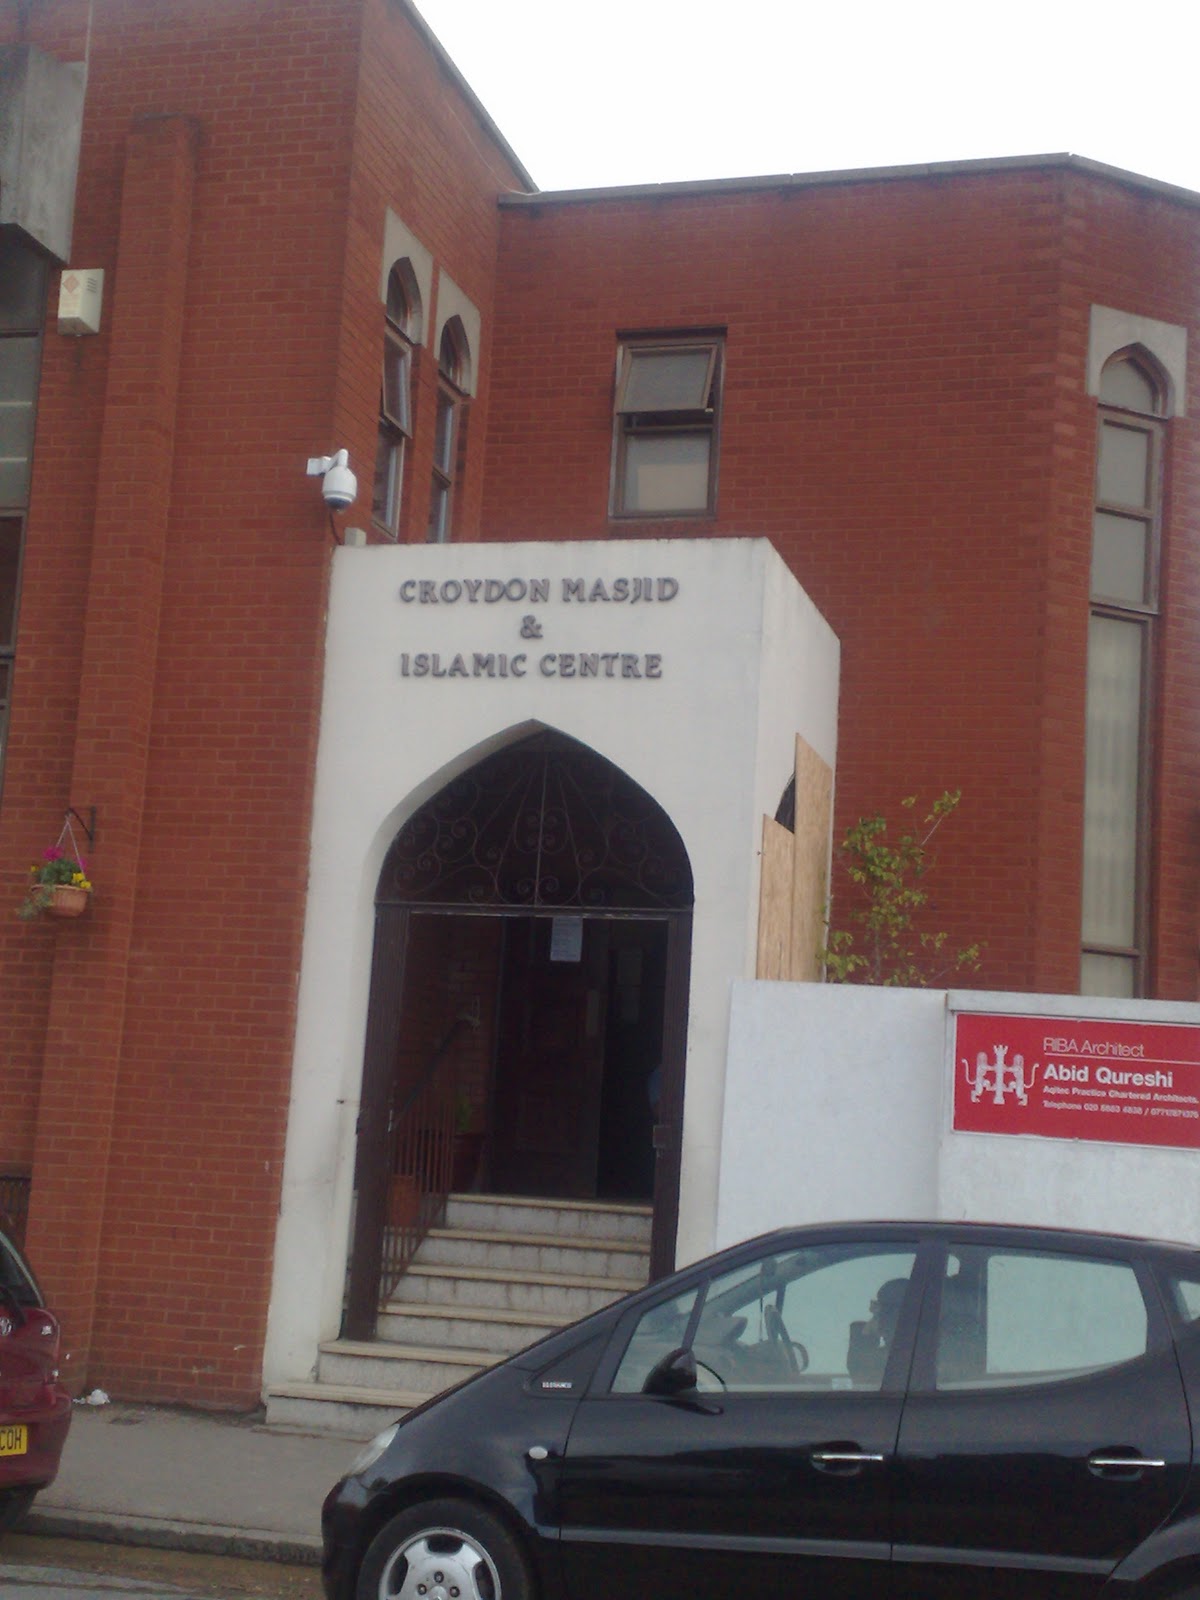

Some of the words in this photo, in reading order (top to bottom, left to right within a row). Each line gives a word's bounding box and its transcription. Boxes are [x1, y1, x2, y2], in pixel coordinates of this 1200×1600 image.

[400, 578, 550, 604] CROYDON
[562, 577, 680, 604] MASJID
[520, 614, 543, 639] &
[401, 653, 527, 678] ISLAMIC
[539, 652, 662, 679] CENTRE
[1043, 1037, 1078, 1053] RIBA
[1080, 1040, 1145, 1058] Architect
[1043, 1063, 1089, 1082] Abid
[1096, 1066, 1173, 1088] Qureshi
[1108, 1089, 1151, 1100] Chartered
